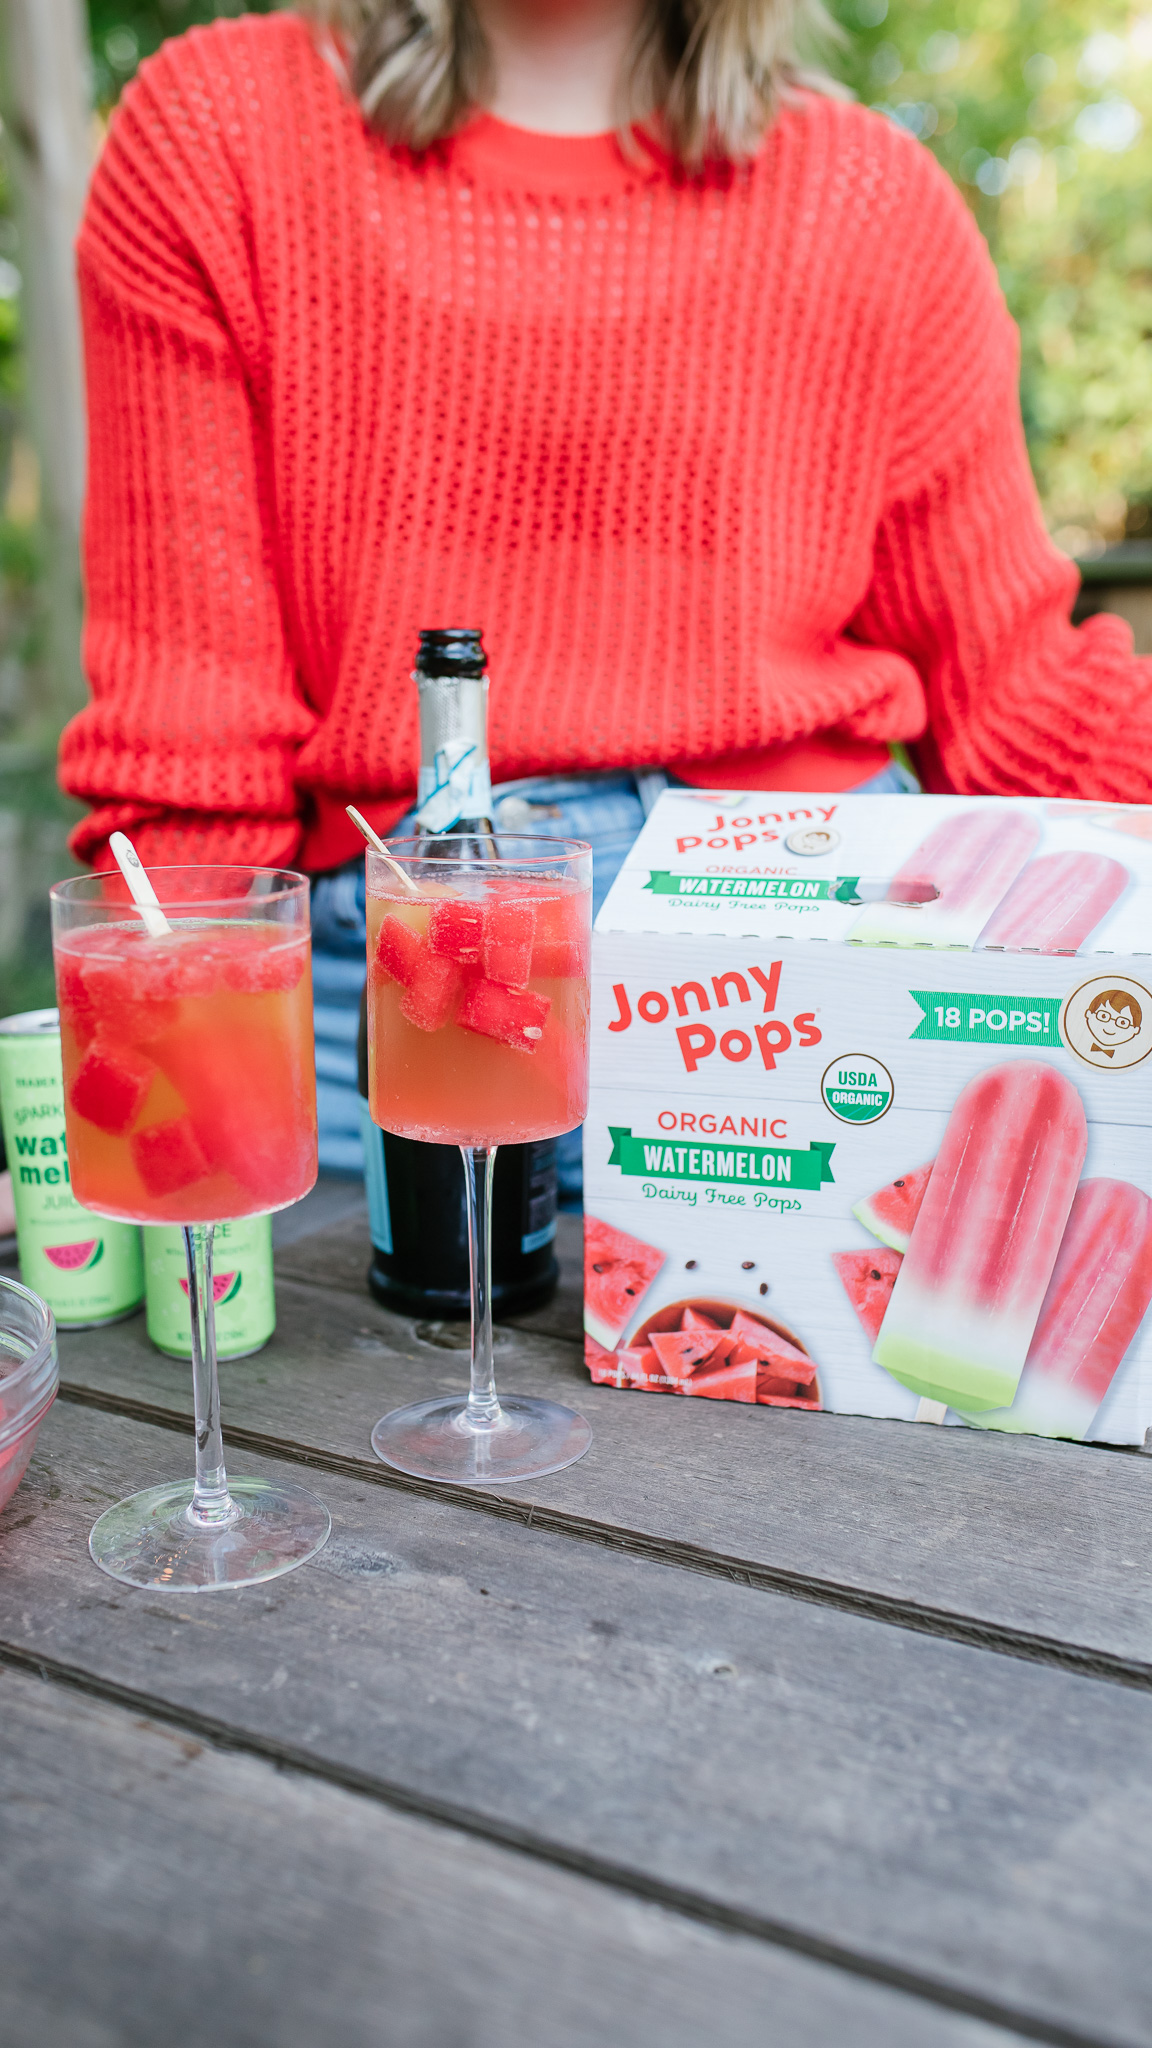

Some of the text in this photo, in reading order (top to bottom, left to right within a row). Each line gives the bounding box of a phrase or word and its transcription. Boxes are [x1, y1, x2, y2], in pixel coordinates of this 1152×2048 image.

[707, 804, 838, 832] Jonny
[675, 829, 780, 853] Pops
[705, 865, 798, 876] ORGANIC
[679, 877, 820, 898] WATERMELON
[668, 898, 820, 914] Dairy Free Pops
[608, 960, 783, 1032] Jonny
[934, 1006, 1050, 1034] 18 POPS!
[675, 1011, 822, 1072] Pops
[838, 1070, 878, 1088] USDA
[832, 1090, 883, 1107] ORGANIC
[13, 1102, 65, 1126] SPARK
[657, 1111, 788, 1139] ORGANIC
[15, 1130, 67, 1156] wat
[19, 1161, 70, 1185] mel
[643, 1144, 792, 1183] WATERMELON
[642, 1183, 802, 1214] Dairy Free Pops
